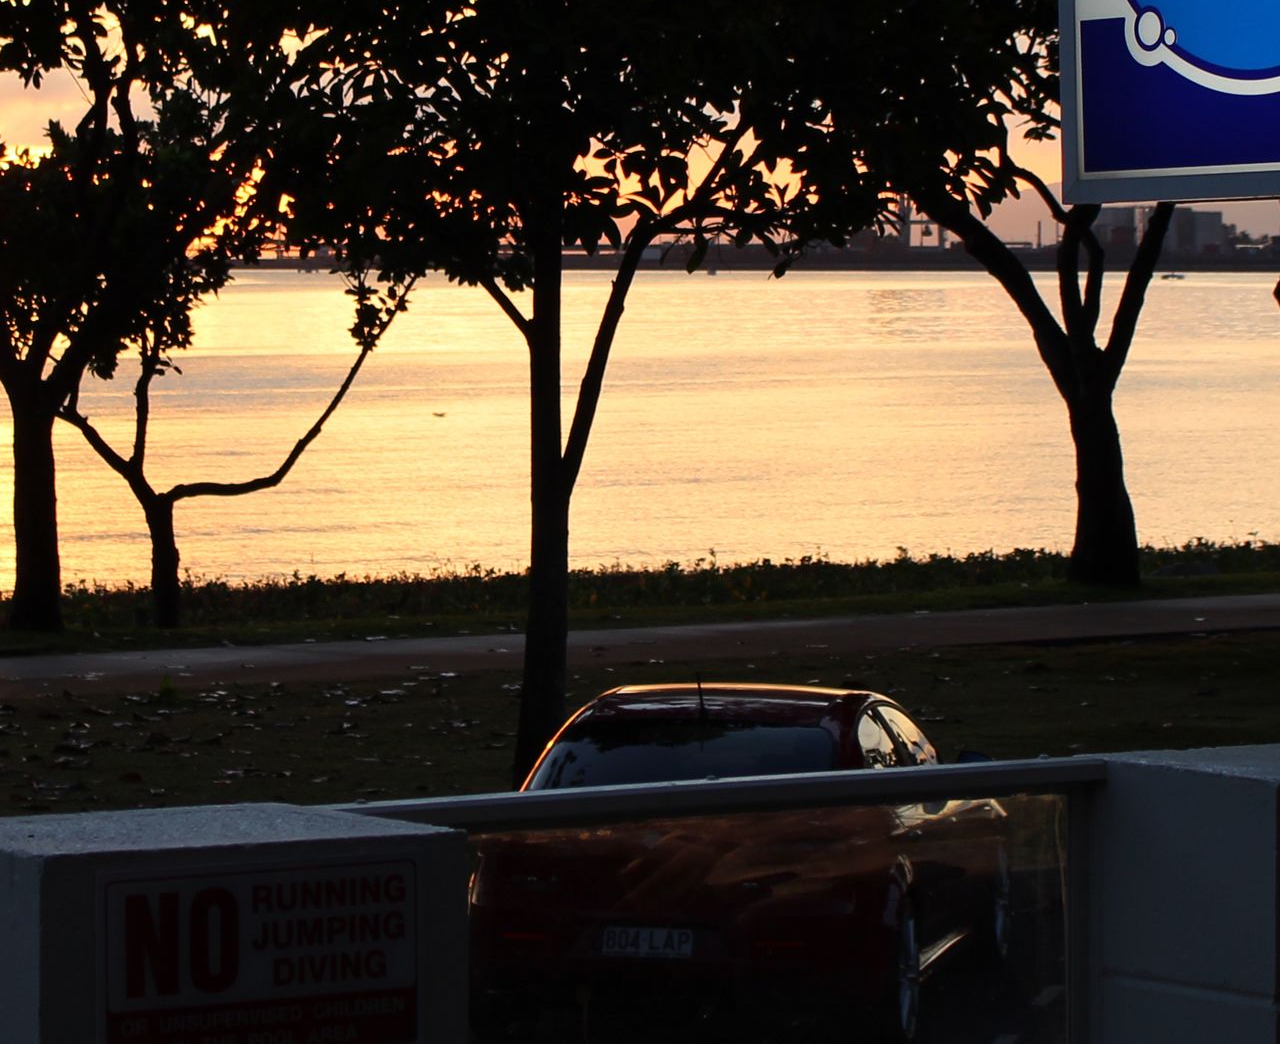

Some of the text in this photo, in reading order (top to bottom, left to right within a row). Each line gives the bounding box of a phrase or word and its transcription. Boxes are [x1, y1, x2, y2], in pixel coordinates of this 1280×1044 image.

[252, 873, 407, 913] RUNNING
[125, 886, 240, 999] NO
[252, 910, 406, 951] JUMPING
[272, 950, 387, 987] DIVING
[313, 995, 407, 1020] CHILDREN
